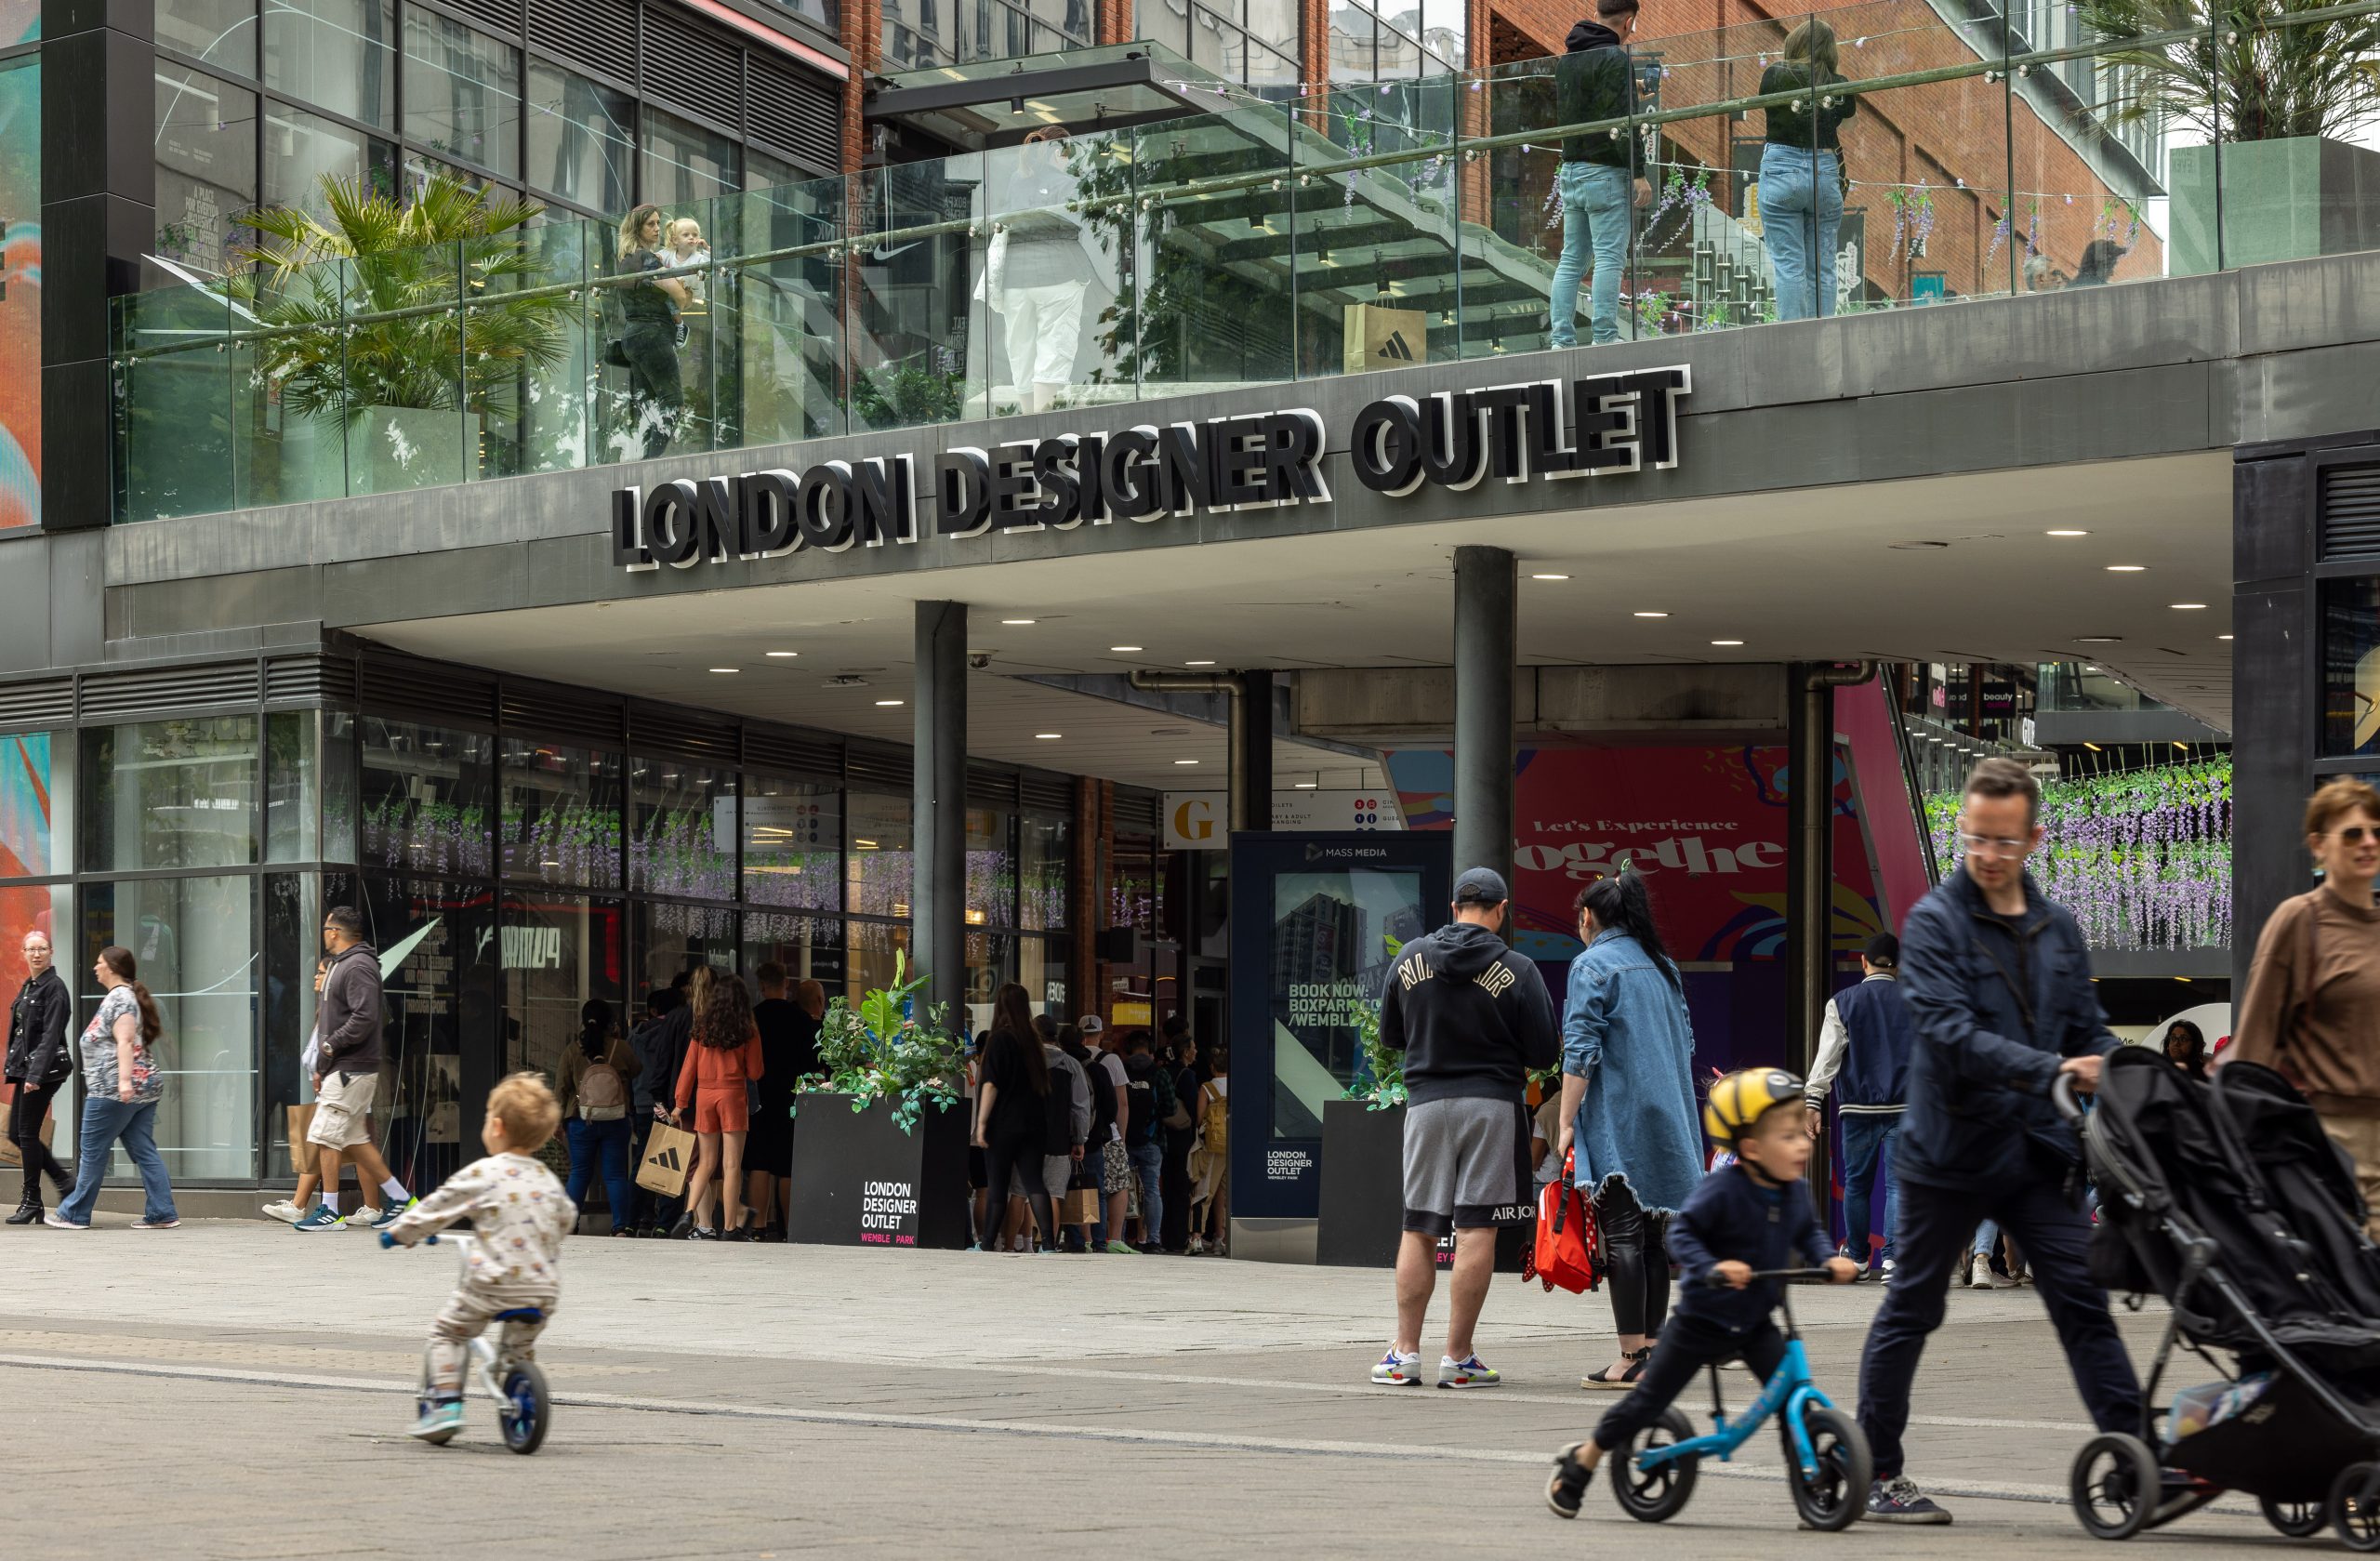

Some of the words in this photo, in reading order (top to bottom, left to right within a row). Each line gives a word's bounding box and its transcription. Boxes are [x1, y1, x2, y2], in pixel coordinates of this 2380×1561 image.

[612, 453, 917, 571] LONDON
[934, 408, 1332, 539] DESIGNER
[1351, 364, 1691, 496] OUTLET
[1983, 693, 2014, 702] beauty
[1173, 800, 1214, 840] G
[1597, 819, 1739, 833] Experience
[1326, 848, 1353, 856] MASS
[1355, 848, 1387, 856] MEDIA
[1514, 836, 1788, 880] ogethe
[1289, 984, 1330, 998] BOOK
[1332, 984, 1369, 998] NOW:
[1289, 1012, 1353, 1026] /WEMBL
[1267, 1151, 1306, 1159] LONDON
[1267, 1158, 1313, 1167] DESIGNER
[1267, 1167, 1302, 1175] OUTLET
[864, 1181, 911, 1197] LONDON
[863, 1197, 917, 1214] DESIGNER
[1491, 1206, 1516, 1221] AIR
[1517, 1205, 1536, 1221] JOR
[862, 1213, 902, 1229] OUTLET
[861, 1232, 891, 1243] WEMBLE
[895, 1235, 915, 1245] PARK
